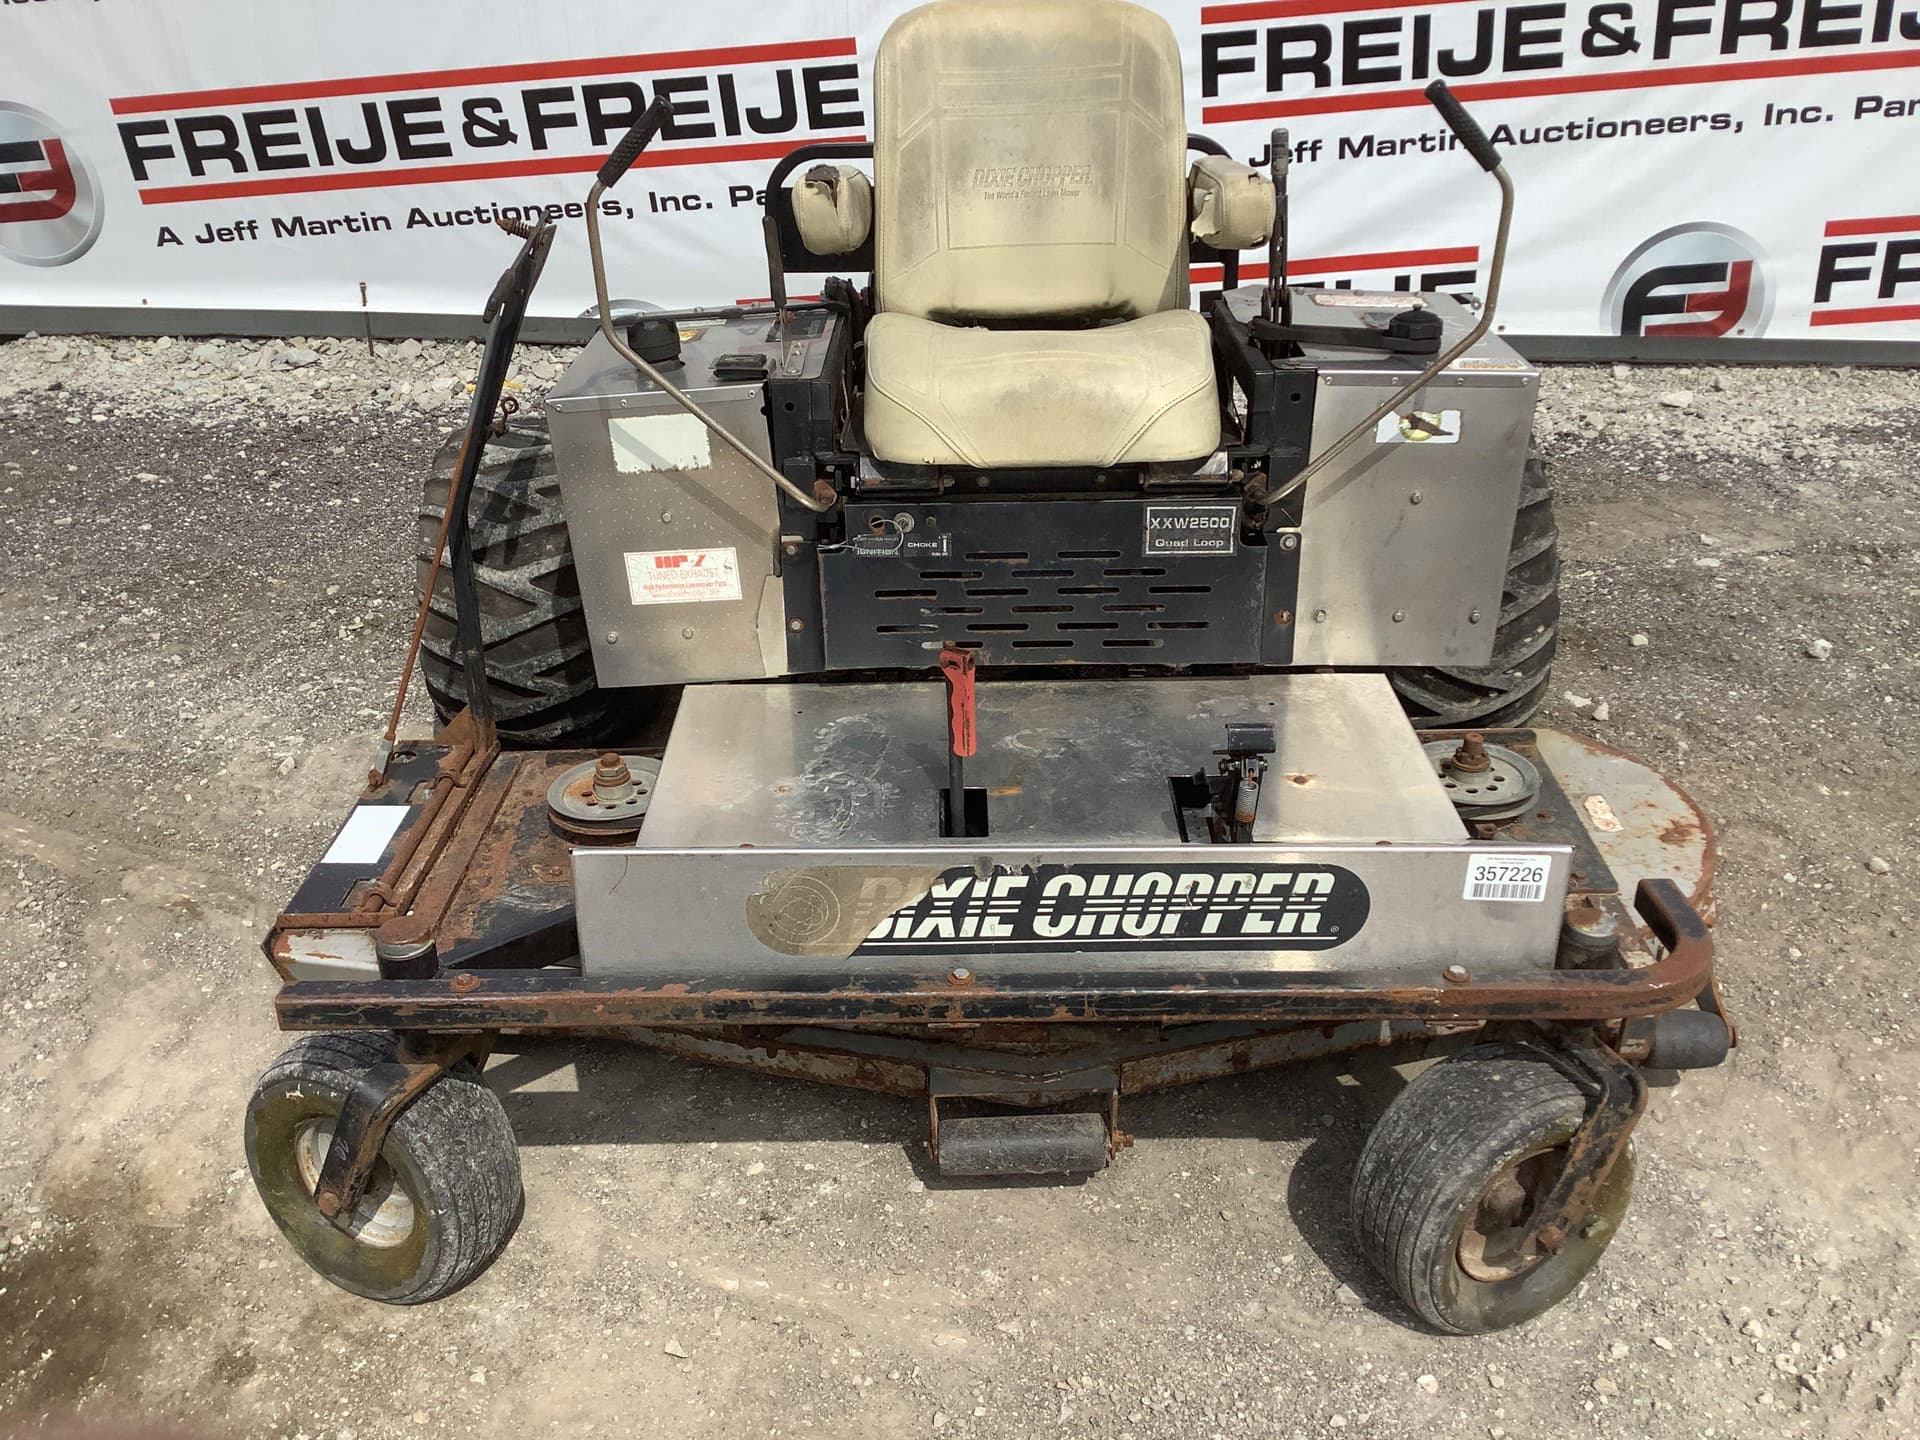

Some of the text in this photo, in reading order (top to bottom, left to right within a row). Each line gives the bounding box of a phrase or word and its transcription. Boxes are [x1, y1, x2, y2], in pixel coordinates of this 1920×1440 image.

[1201, 2, 1566, 98] FREIJE
[1581, 2, 1641, 58] &
[116, 63, 866, 182] FREIJE & FREIJE
[1490, 112, 1744, 146] Auctioneers,
[1763, 102, 1834, 127] Inc.
[156, 226, 183, 248] A
[194, 218, 259, 245] Jeff
[272, 211, 392, 239] Martin
[649, 191, 713, 213] Inc.
[1150, 517, 1230, 529] XXW2500
[1155, 538, 1224, 549] Quad Loop
[648, 570, 679, 581] TUNED
[1474, 866, 1544, 883] 357226
[1032, 871, 1336, 938] CHOPPER
